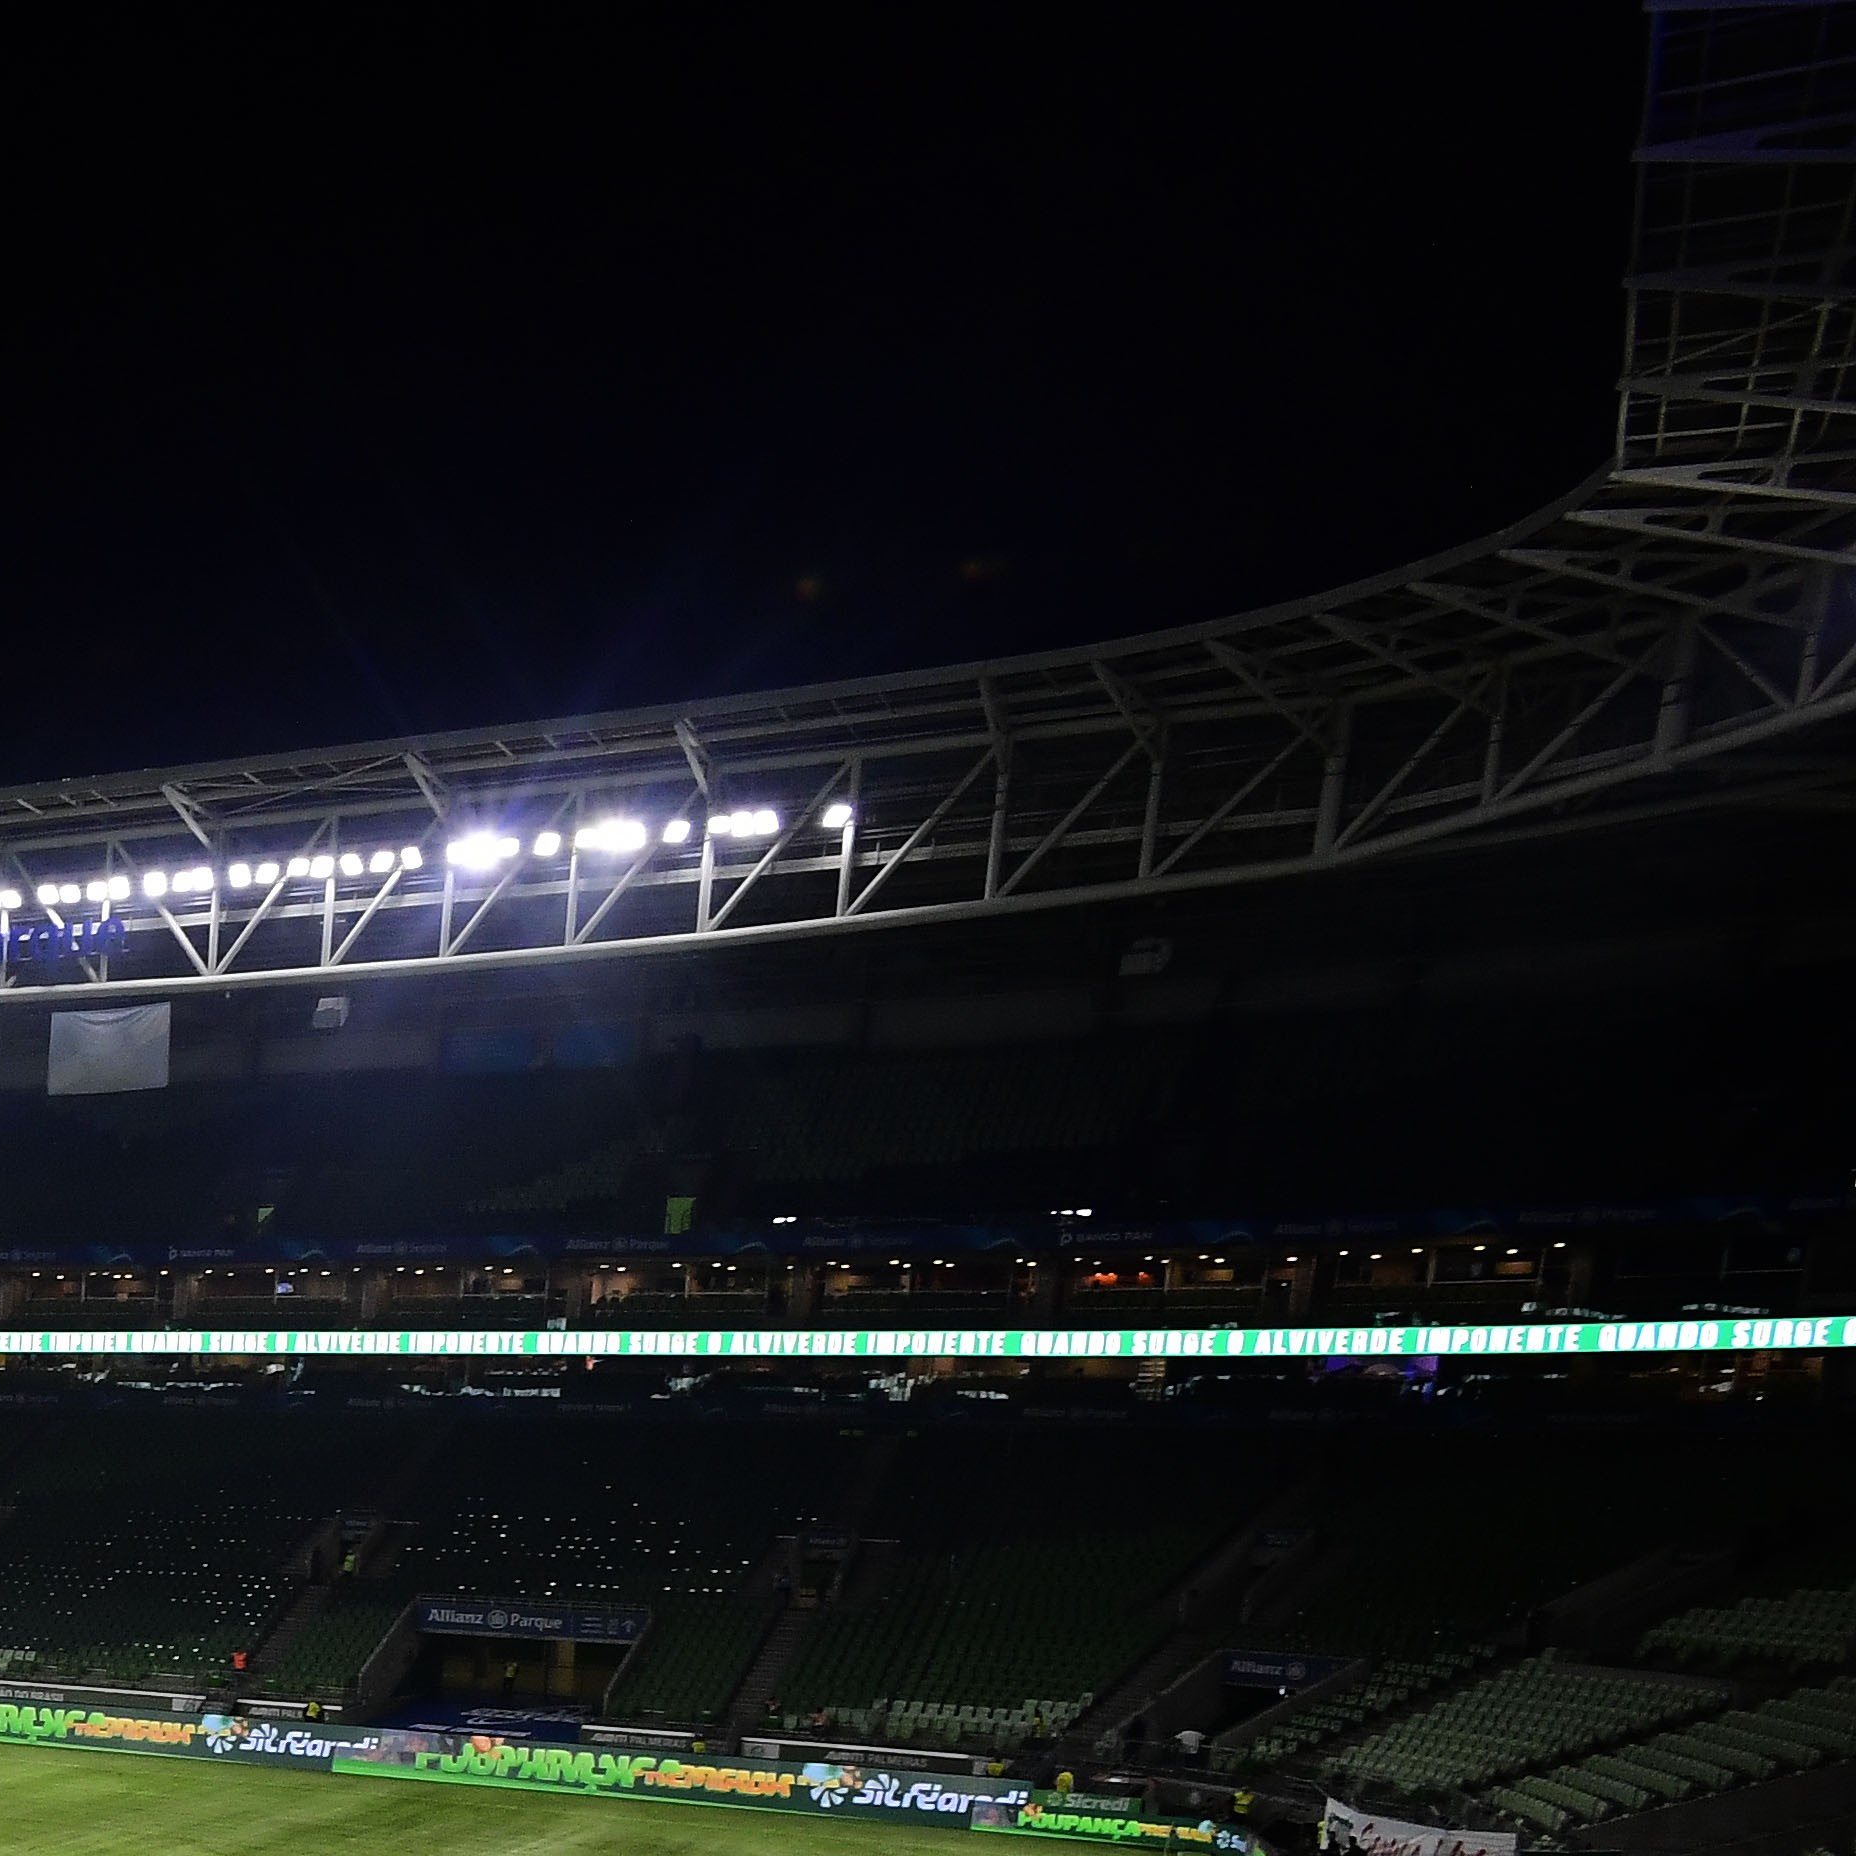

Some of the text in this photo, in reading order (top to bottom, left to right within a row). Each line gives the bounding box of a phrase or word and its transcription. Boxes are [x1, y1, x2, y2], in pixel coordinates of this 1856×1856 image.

[707, 1332, 722, 1355] O
[1021, 1331, 1121, 1356] QUANDO
[1132, 1331, 1217, 1355] SURGE
[1227, 1330, 1244, 1355] O
[1254, 1328, 1406, 1355] ALVIVERDE
[1416, 1325, 1582, 1353] IMPONENTE
[1598, 1322, 1718, 1351] QUANDO
[1732, 1318, 1833, 1348] SURGE
[428, 1608, 563, 1632] Allianz Parque
[1062, 1792, 1130, 1812] Sicredi
